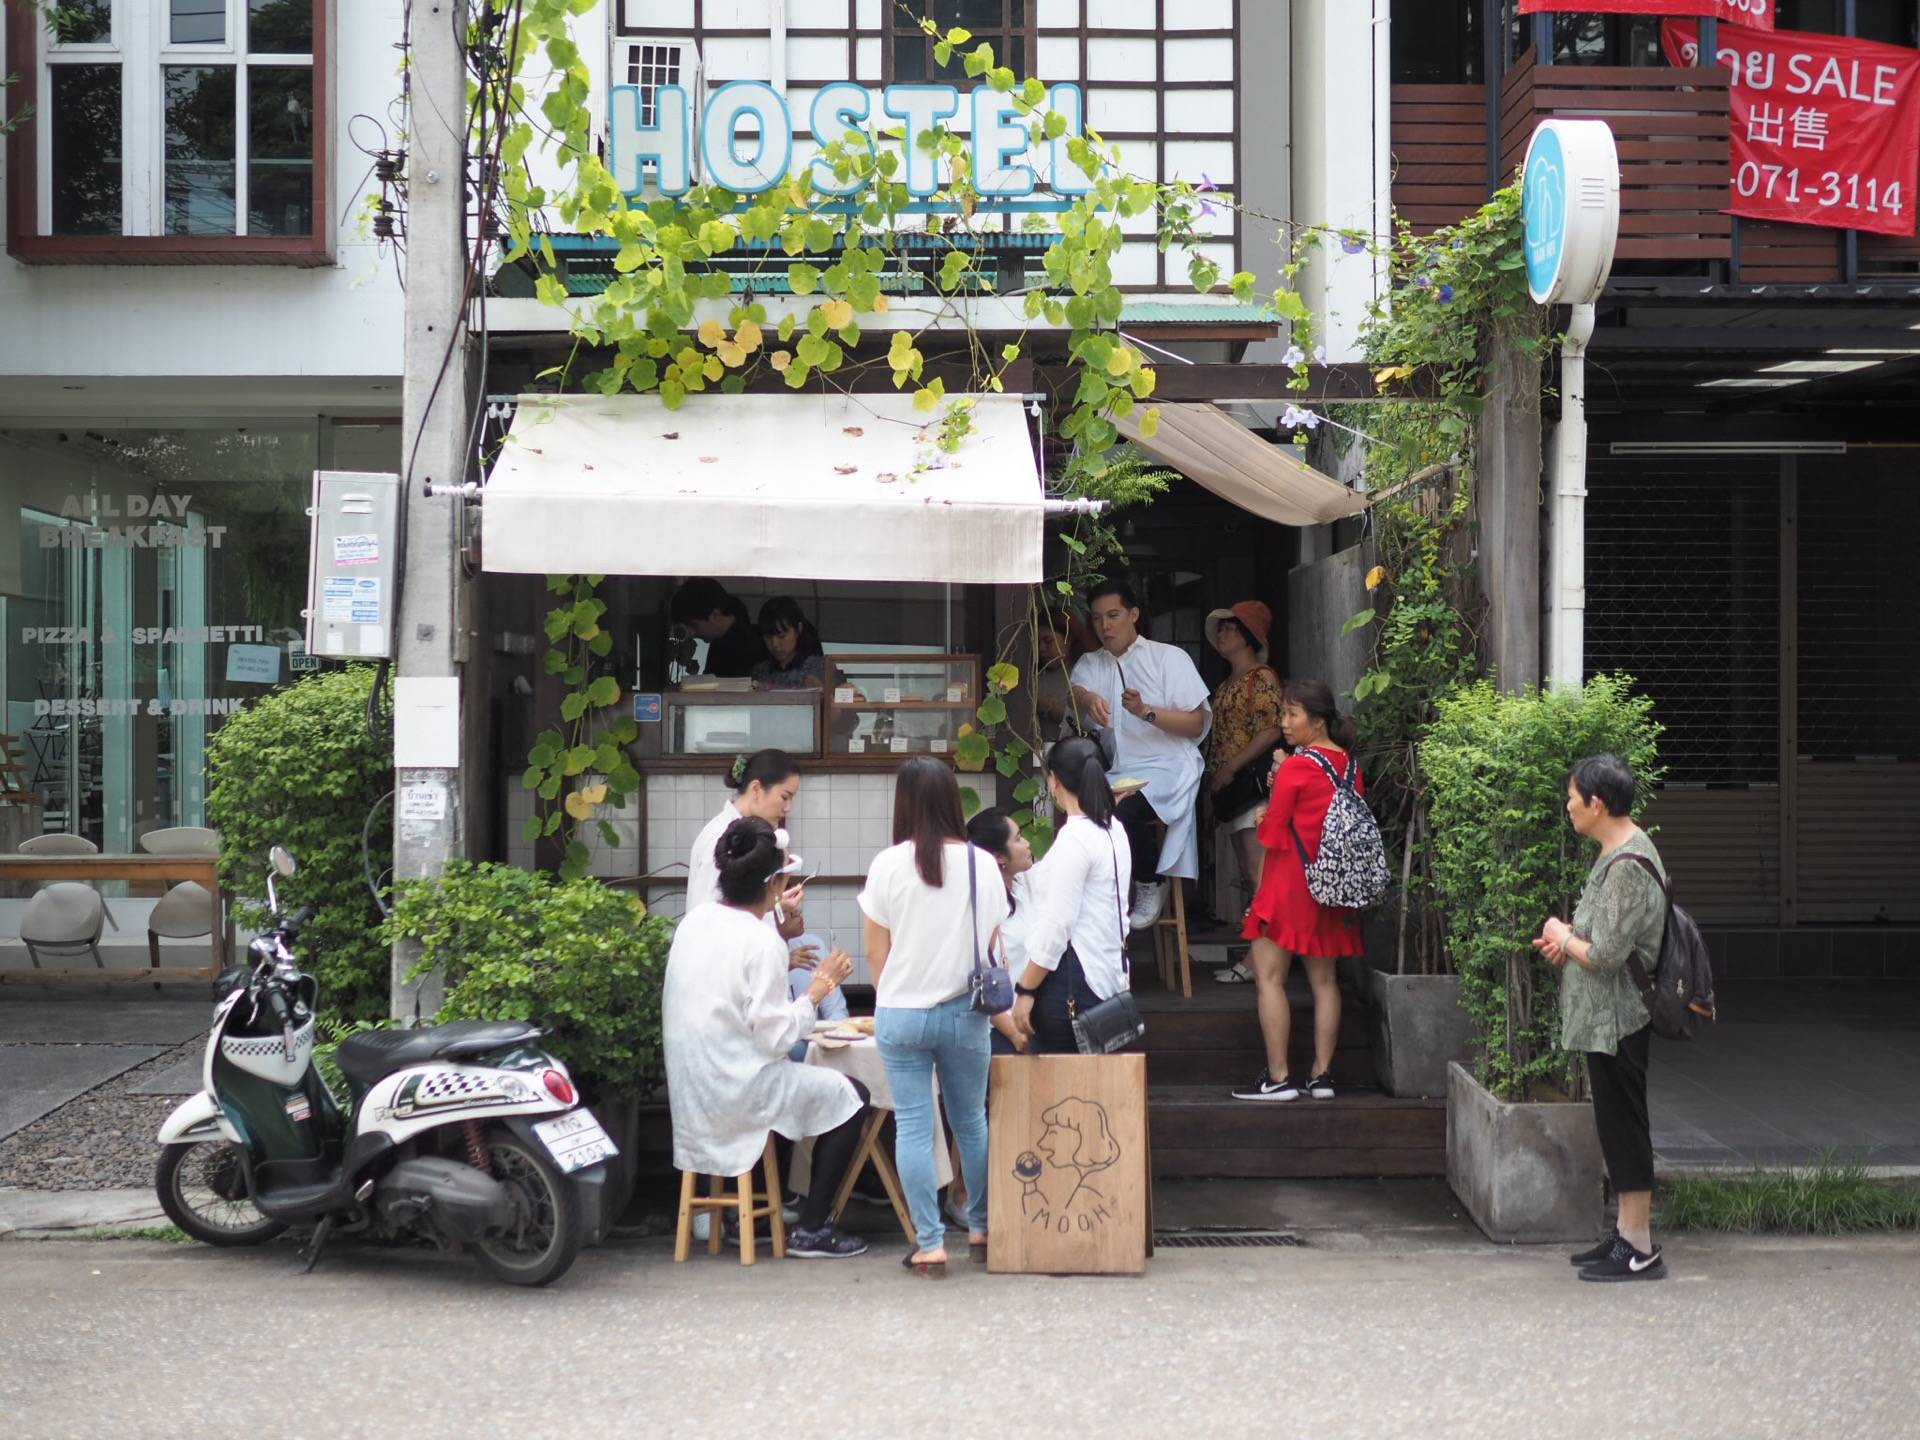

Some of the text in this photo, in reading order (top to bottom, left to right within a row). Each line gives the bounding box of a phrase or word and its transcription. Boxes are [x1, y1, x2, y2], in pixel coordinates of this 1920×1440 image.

[1785, 53, 1897, 106] SALE
[1747, 102, 1829, 151] 出售
[608, 80, 1108, 198] HOSTEL
[60, 494, 192, 517] ALL DAY
[39, 525, 227, 549] BREAKFAST
[22, 627, 88, 644] PIZZA
[292, 657, 317, 669] OPEN
[34, 699, 142, 716] DESSERT
[147, 699, 164, 715] &
